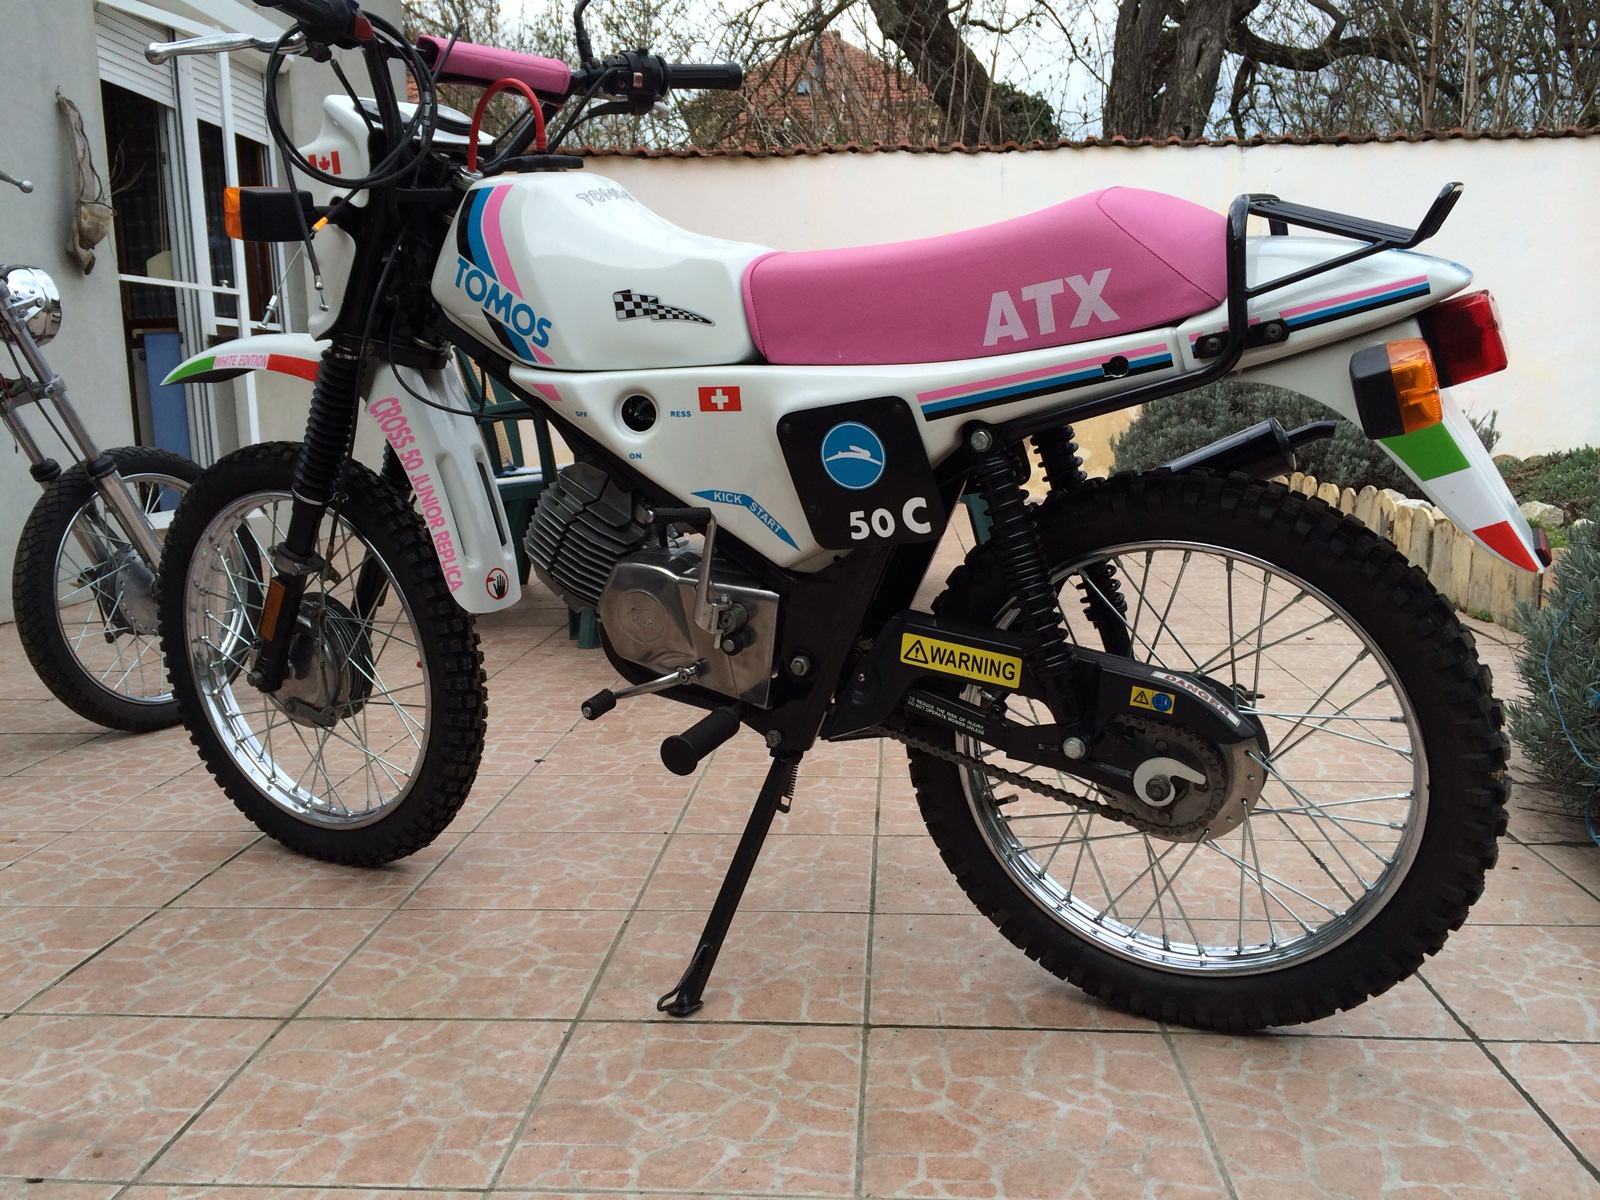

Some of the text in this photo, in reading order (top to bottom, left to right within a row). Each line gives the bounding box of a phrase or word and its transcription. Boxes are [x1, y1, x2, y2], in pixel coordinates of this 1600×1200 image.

[576, 187, 634, 206] TOM
[455, 256, 553, 348] TOMOS
[982, 267, 1120, 347] ATX
[215, 354, 266, 367] WHITE EDITION
[670, 410, 692, 418] RESS
[369, 397, 464, 593] CROSS 50 JUNIOR REPLICA
[713, 491, 783, 534] KICK START
[850, 496, 932, 540] 50 C
[930, 645, 1015, 680] WARNING
[1164, 675, 1229, 716] DANGER
